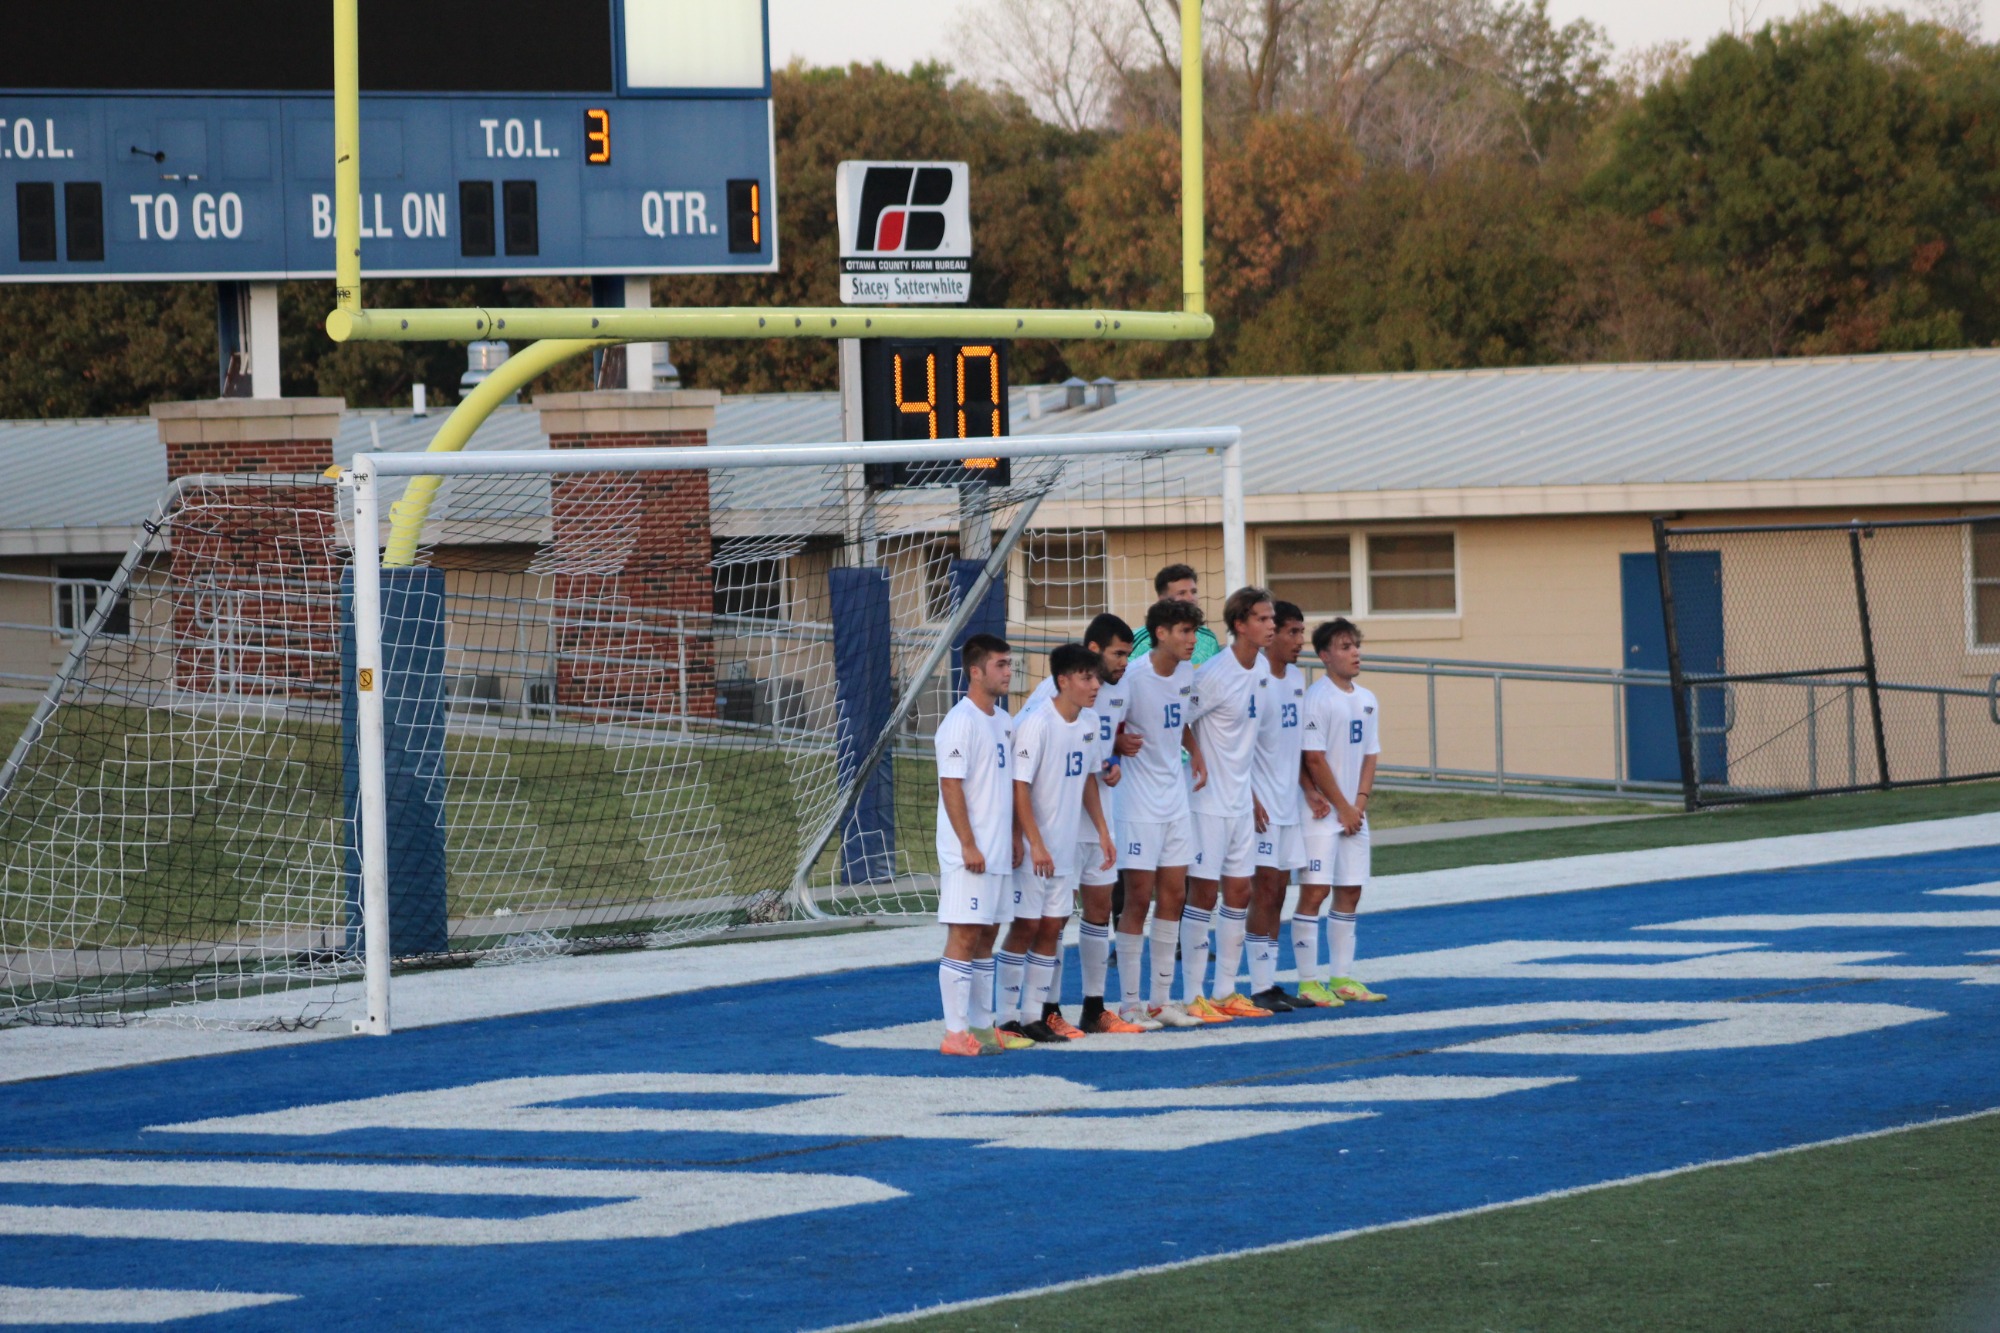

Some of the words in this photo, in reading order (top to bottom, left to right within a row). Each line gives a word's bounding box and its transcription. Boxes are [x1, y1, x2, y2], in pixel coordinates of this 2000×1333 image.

[480, 118, 560, 158] T.O.L.
[587, 109, 610, 162] 3
[130, 193, 179, 240] TO
[192, 192, 243, 240] GO
[311, 192, 393, 239] BLL
[401, 192, 447, 238] ON
[641, 191, 718, 237] QTR.
[845, 260, 876, 271] OTTAWA
[878, 260, 909, 270] COUNTY
[911, 260, 933, 270] FARM
[934, 260, 967, 270] BUREAU
[852, 277, 889, 300] Stacey
[894, 277, 964, 296] Satterwhite
[1164, 703, 1181, 729] 15
[1281, 703, 1298, 728] 23
[997, 742, 1006, 768] 3
[1065, 751, 1083, 777] 13
[1127, 842, 1142, 856] 15
[1195, 852, 1203, 865] 4
[1257, 841, 1273, 855] 23
[1309, 859, 1321, 872] 18
[970, 897, 978, 910] 3
